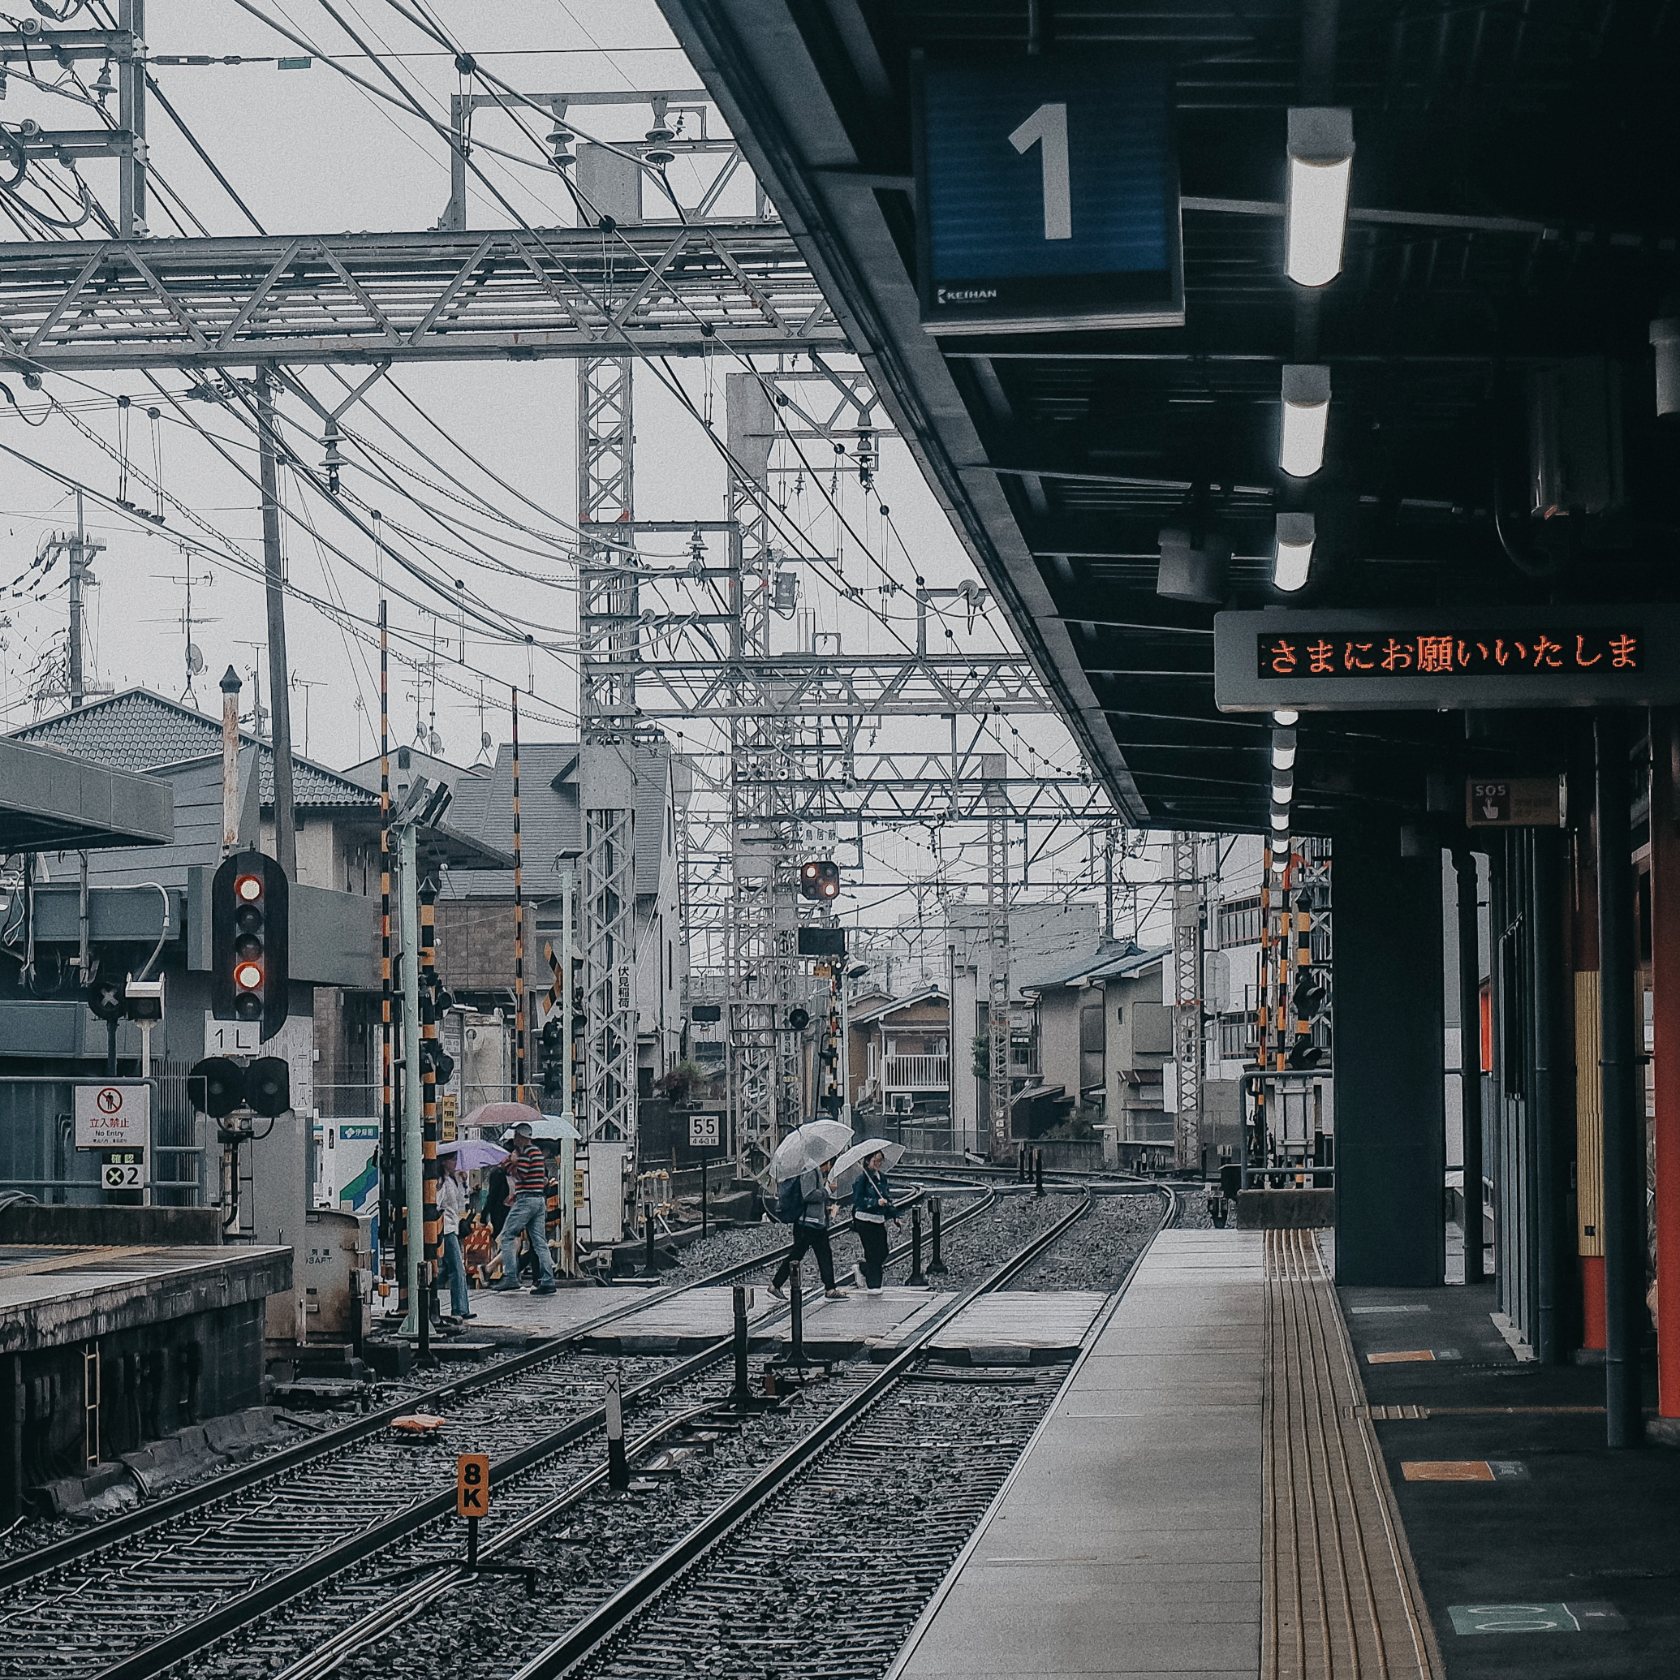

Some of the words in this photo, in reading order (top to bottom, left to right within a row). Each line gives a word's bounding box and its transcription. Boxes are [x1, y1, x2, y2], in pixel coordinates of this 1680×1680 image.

[1007, 103, 1072, 240] 1
[946, 289, 997, 300] KEIHAN
[1261, 634, 1637, 673] さまにお願いいたしま
[1475, 785, 1506, 797] SOS
[617, 965, 630, 1008] 伏見稲荷
[89, 1117, 130, 1129] 立入禁止
[693, 1118, 715, 1135] 55
[106, 1130, 125, 1138] Entry
[126, 1166, 140, 1185] 2
